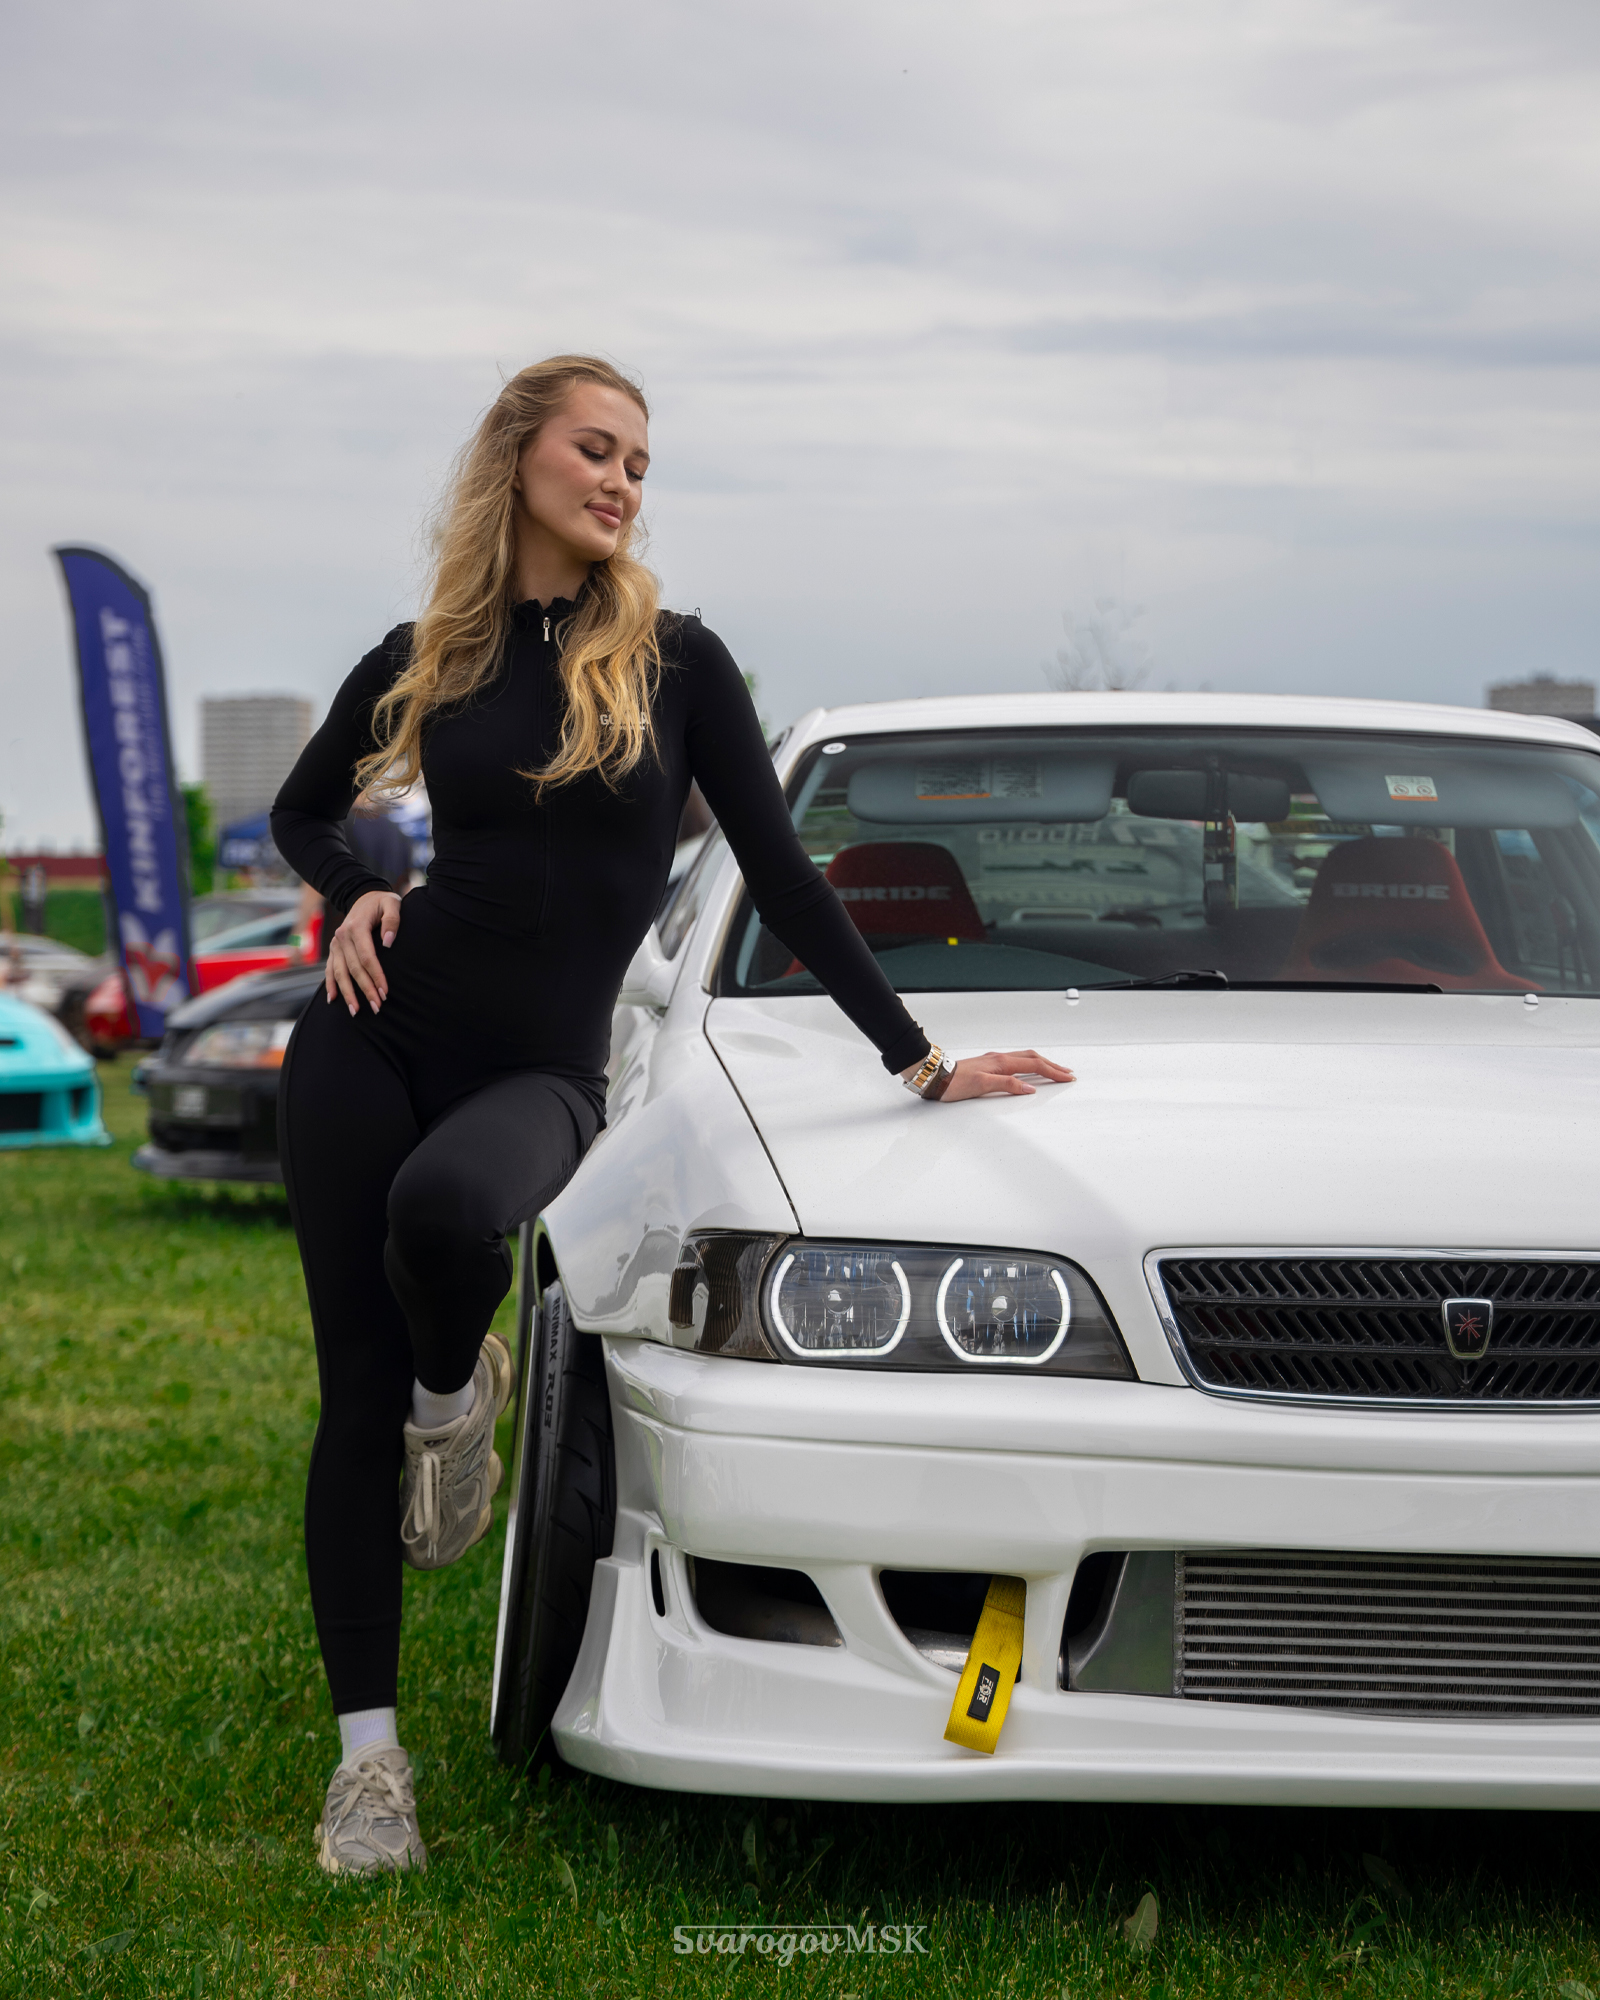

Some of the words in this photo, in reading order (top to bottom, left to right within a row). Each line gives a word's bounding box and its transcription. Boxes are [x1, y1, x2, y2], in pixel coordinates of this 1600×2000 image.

[101, 606, 163, 914] KINFOREST
[836, 885, 951, 902] BRIDE
[1330, 883, 1450, 900] BRIDE
[549, 1296, 561, 1362] REVIMAX
